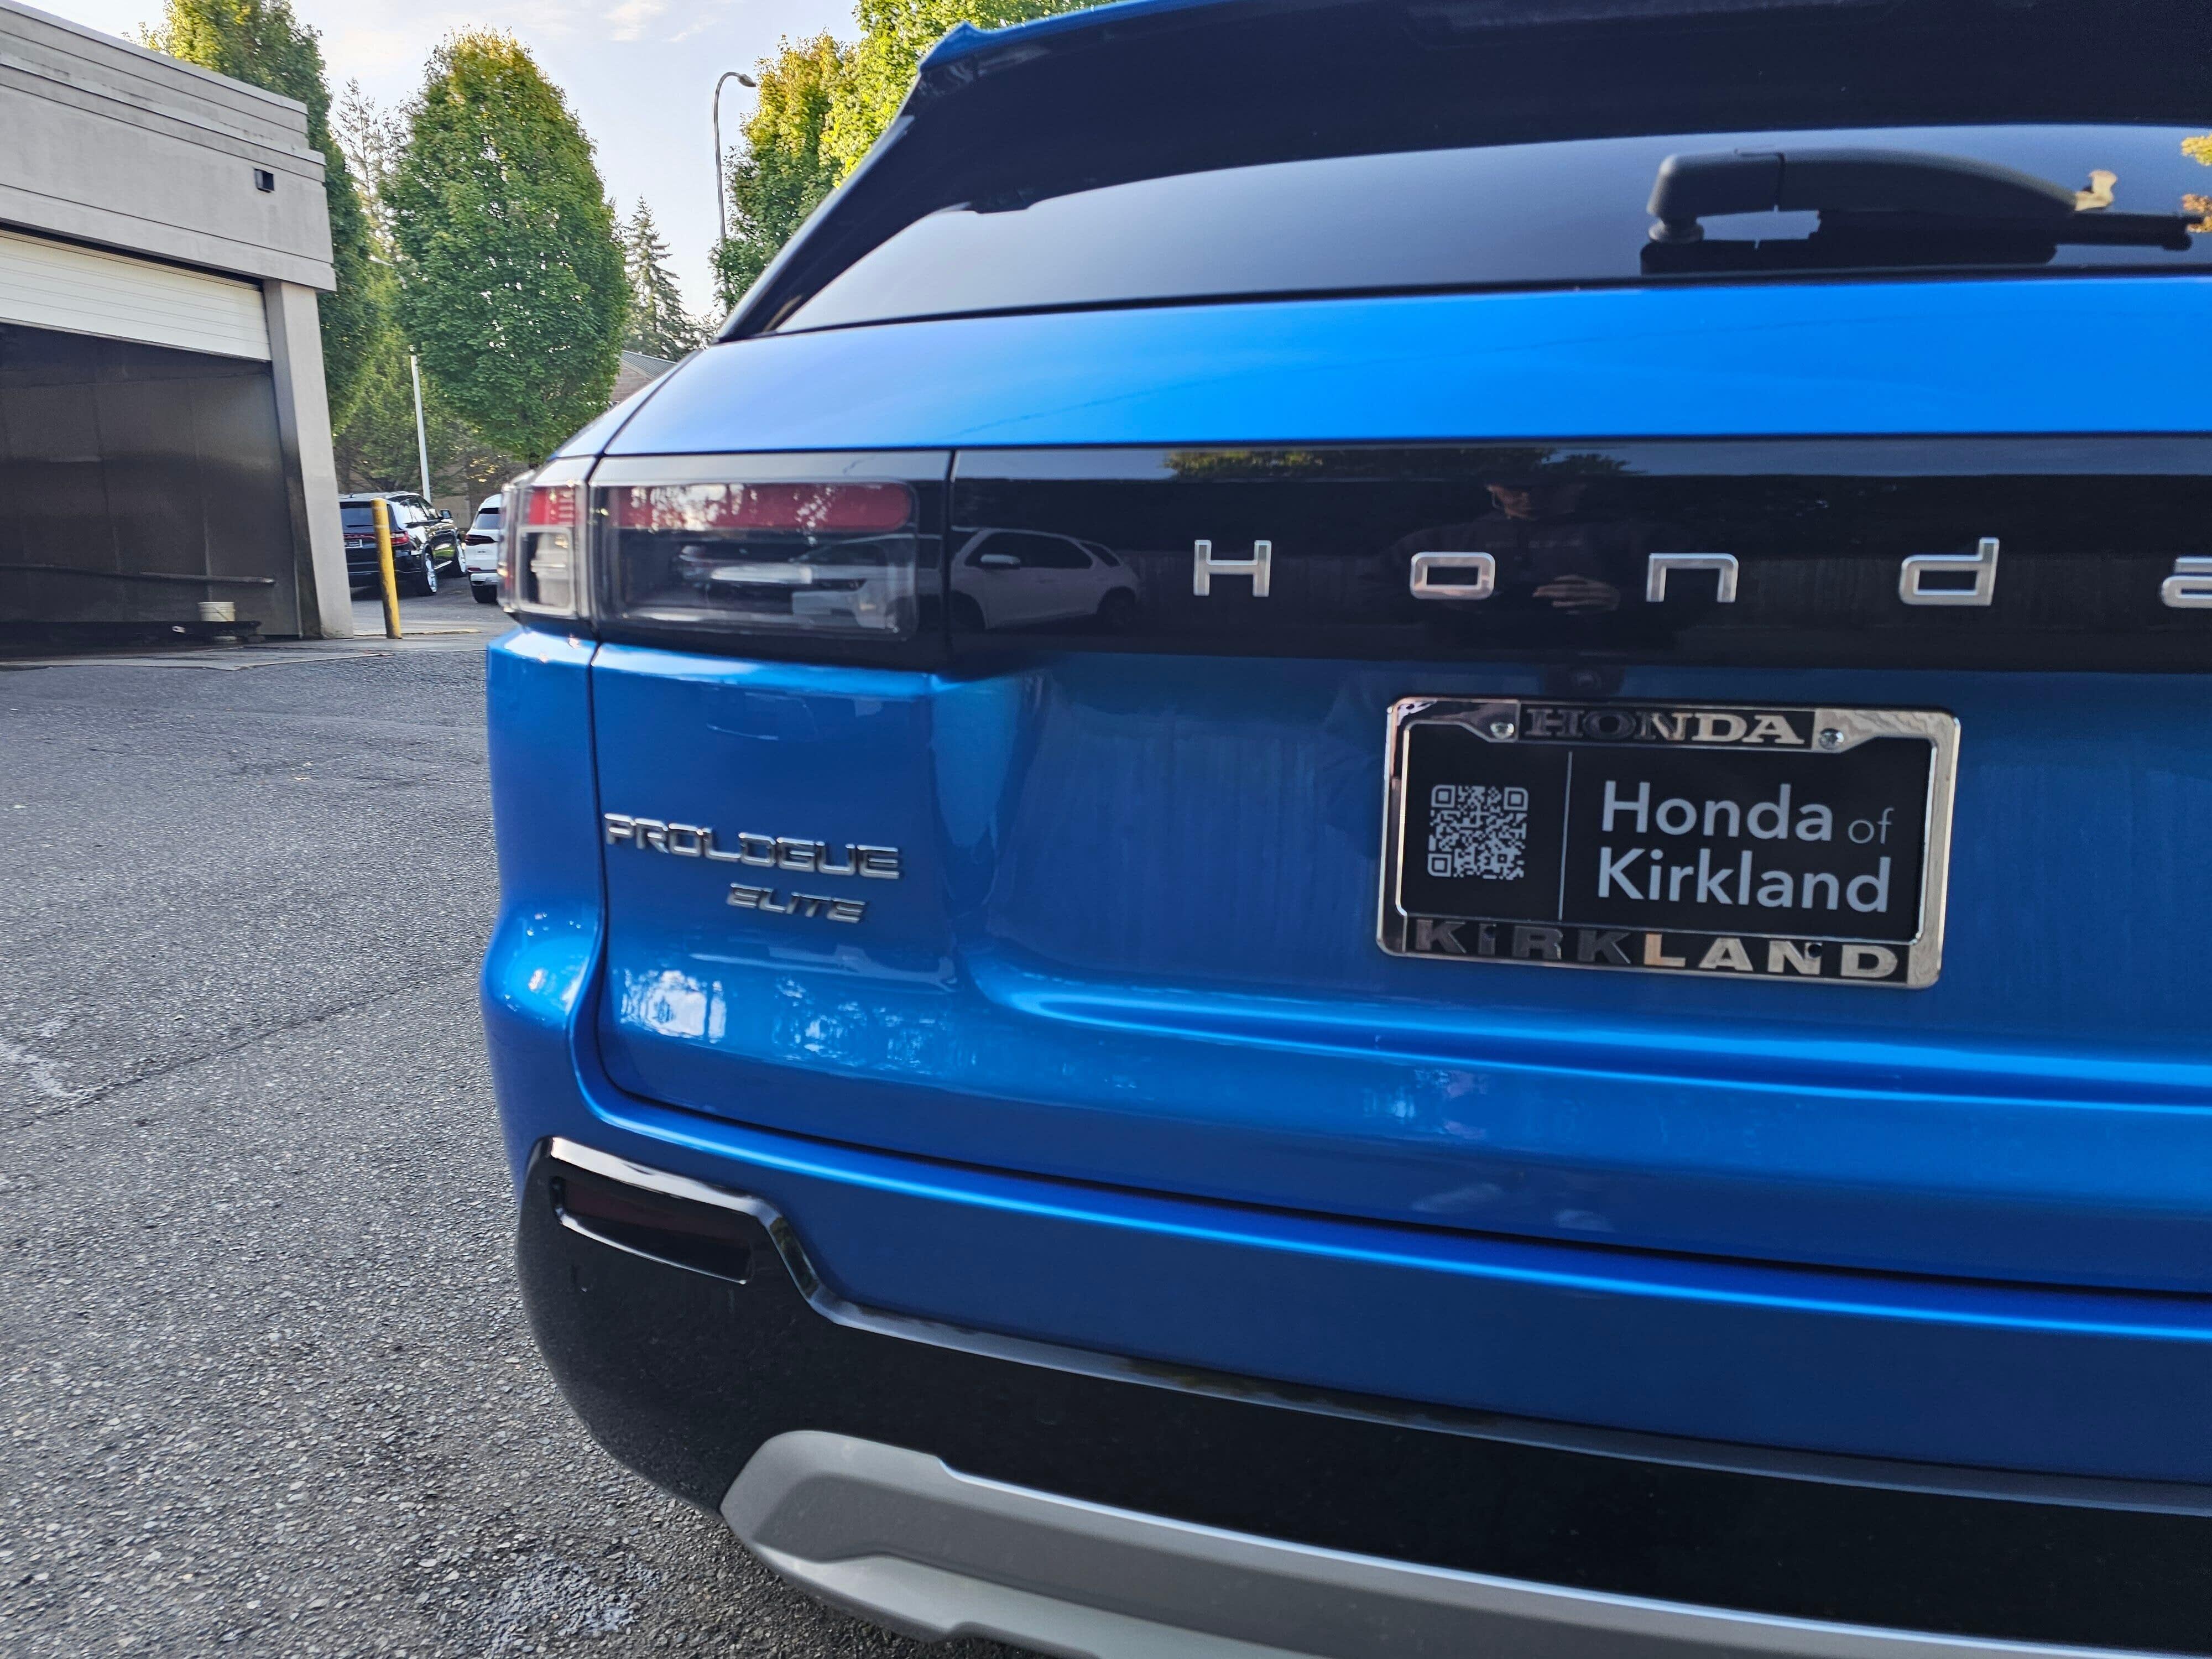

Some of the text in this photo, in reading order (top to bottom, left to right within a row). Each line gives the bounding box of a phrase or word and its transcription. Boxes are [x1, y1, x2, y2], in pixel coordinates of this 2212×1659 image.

[1525, 707, 1805, 744] HONDA
[1601, 780, 1894, 844] Honda of
[604, 813, 900, 880] PROLOGUE
[726, 882, 867, 924] ELITE
[1598, 846, 1891, 913] Kirkland
[1413, 918, 1899, 978] KIRKLAND
